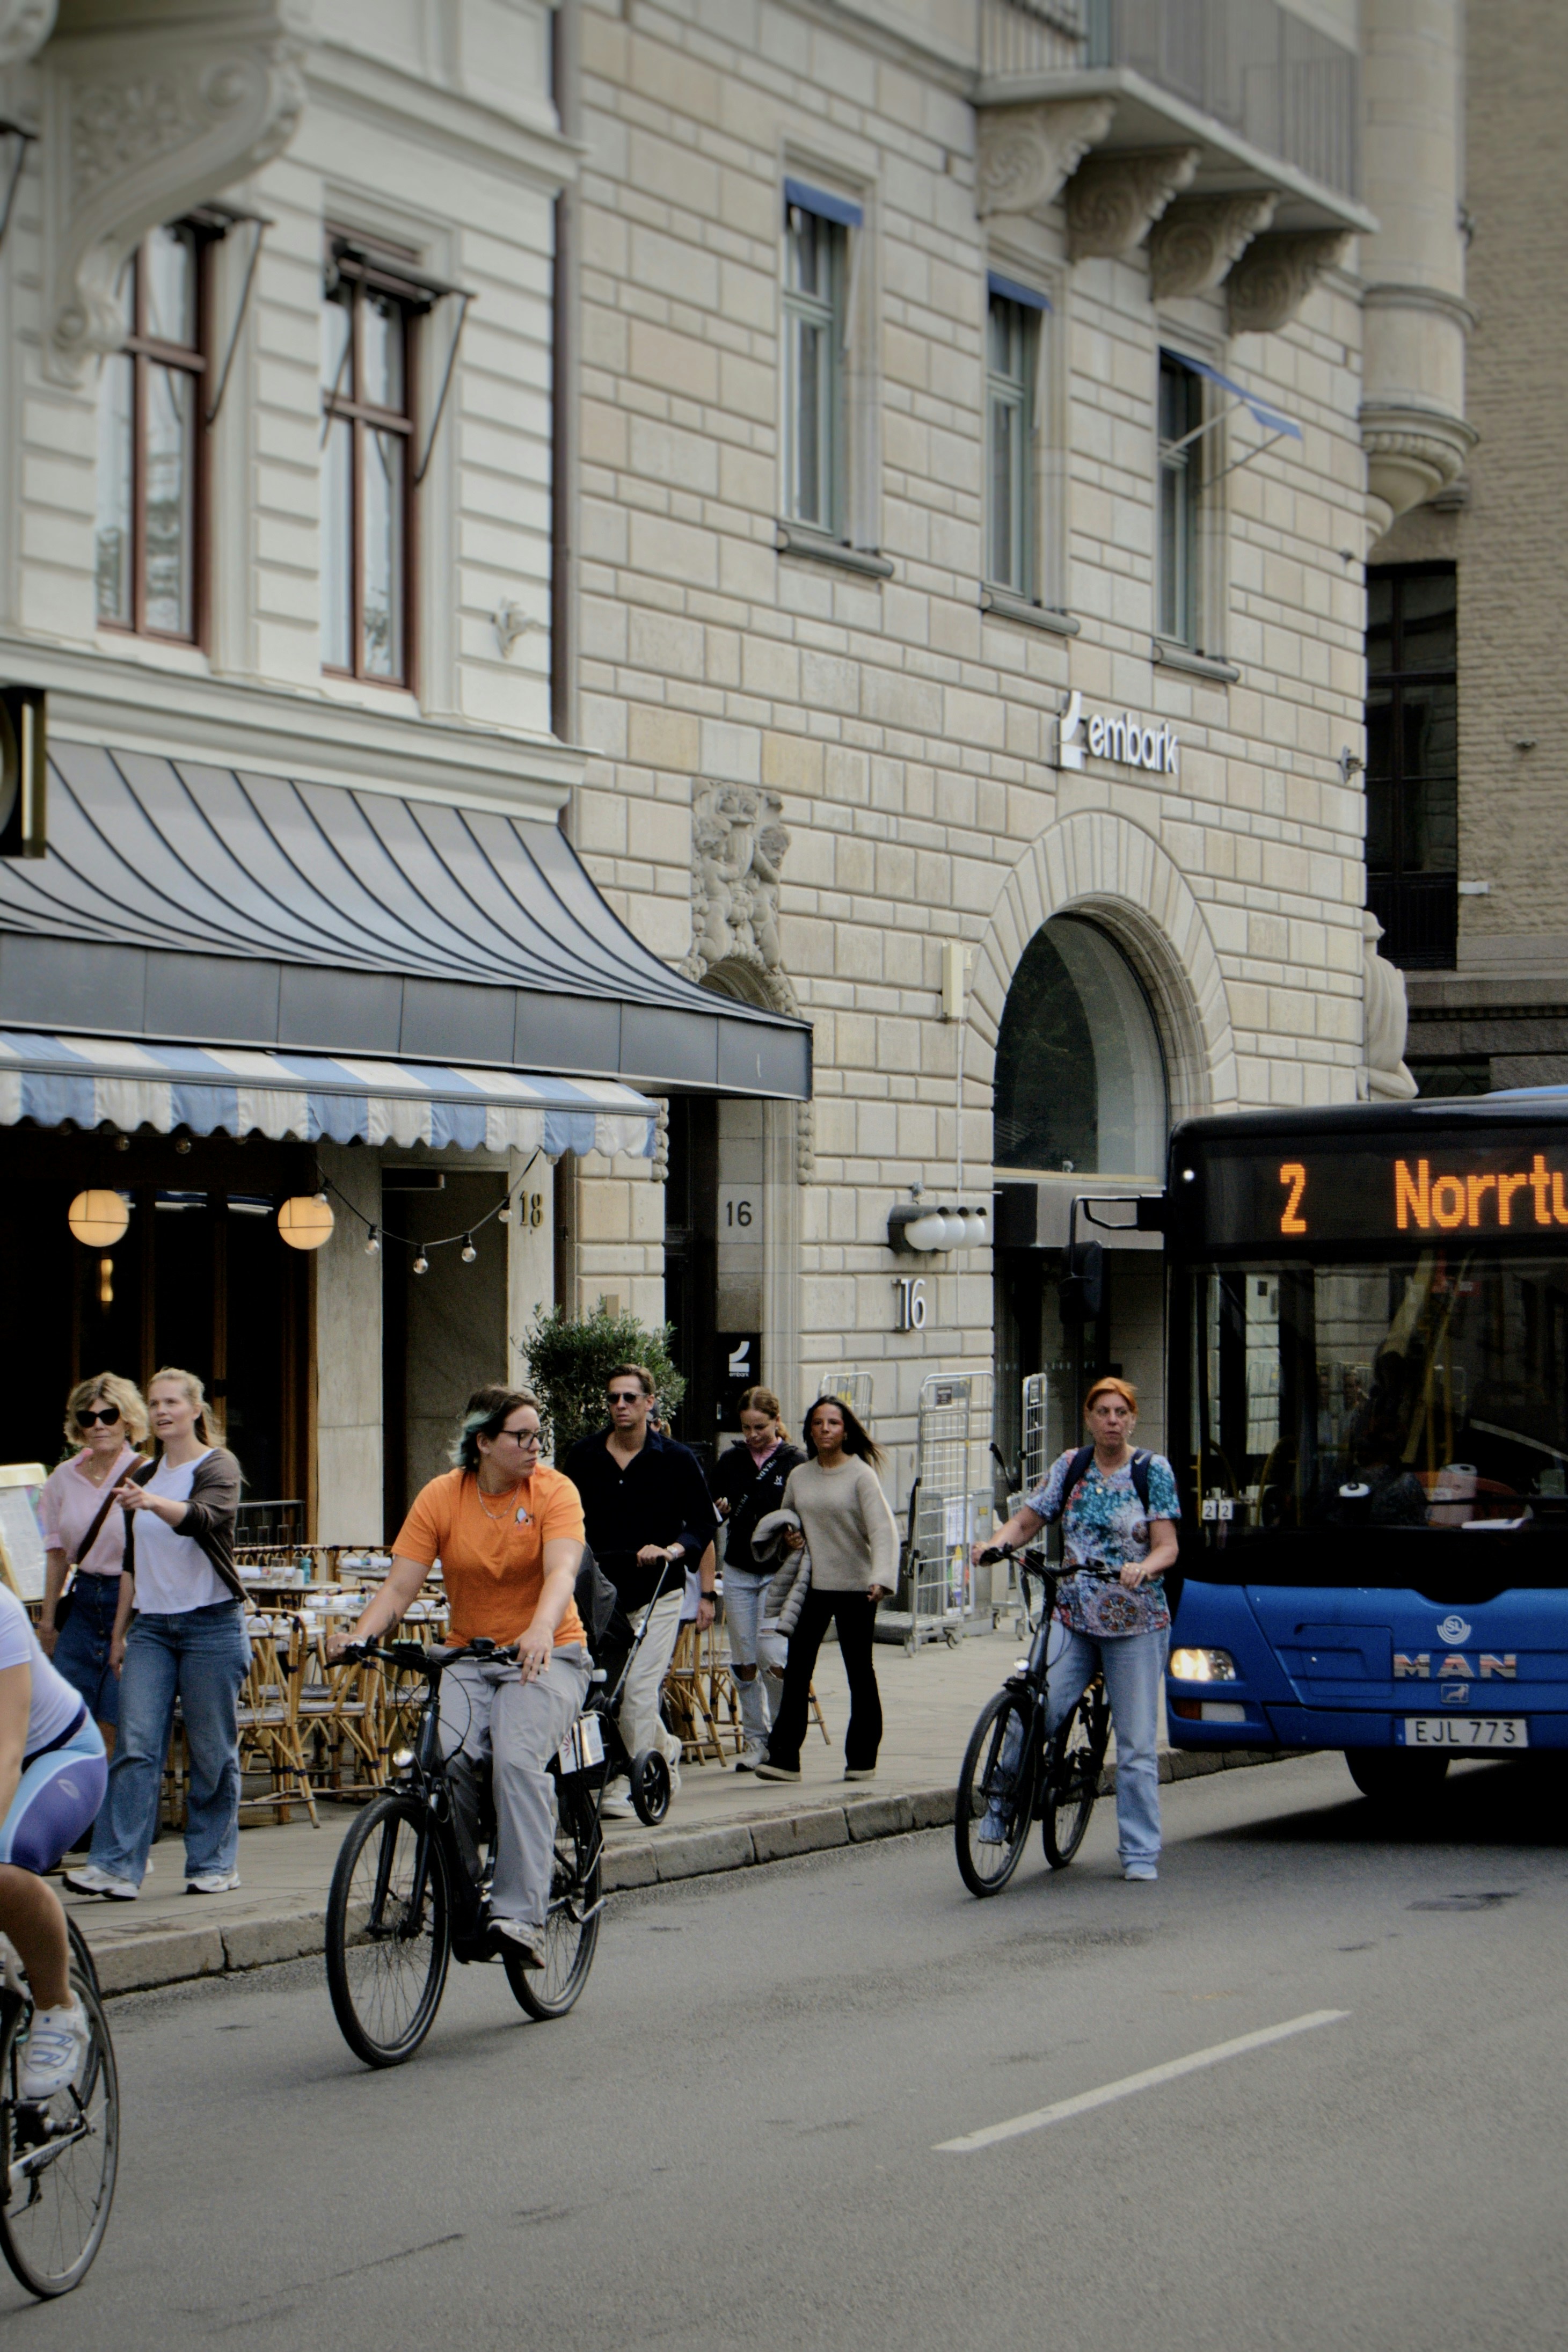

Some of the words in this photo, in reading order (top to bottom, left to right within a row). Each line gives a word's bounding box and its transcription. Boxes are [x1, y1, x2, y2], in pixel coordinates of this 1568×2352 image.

[1089, 712, 1178, 774] embark
[520, 1190, 544, 1227] 18
[726, 1200, 752, 1227] 16
[1280, 1163, 1307, 1233] 2
[900, 1278, 926, 1330] 16
[1205, 1505, 1212, 1517] 2
[1222, 1505, 1229, 1517] 2
[1393, 1654, 1517, 1678] MAN
[1416, 1721, 1460, 1743] EJL
[1469, 1721, 1516, 1743] 773
